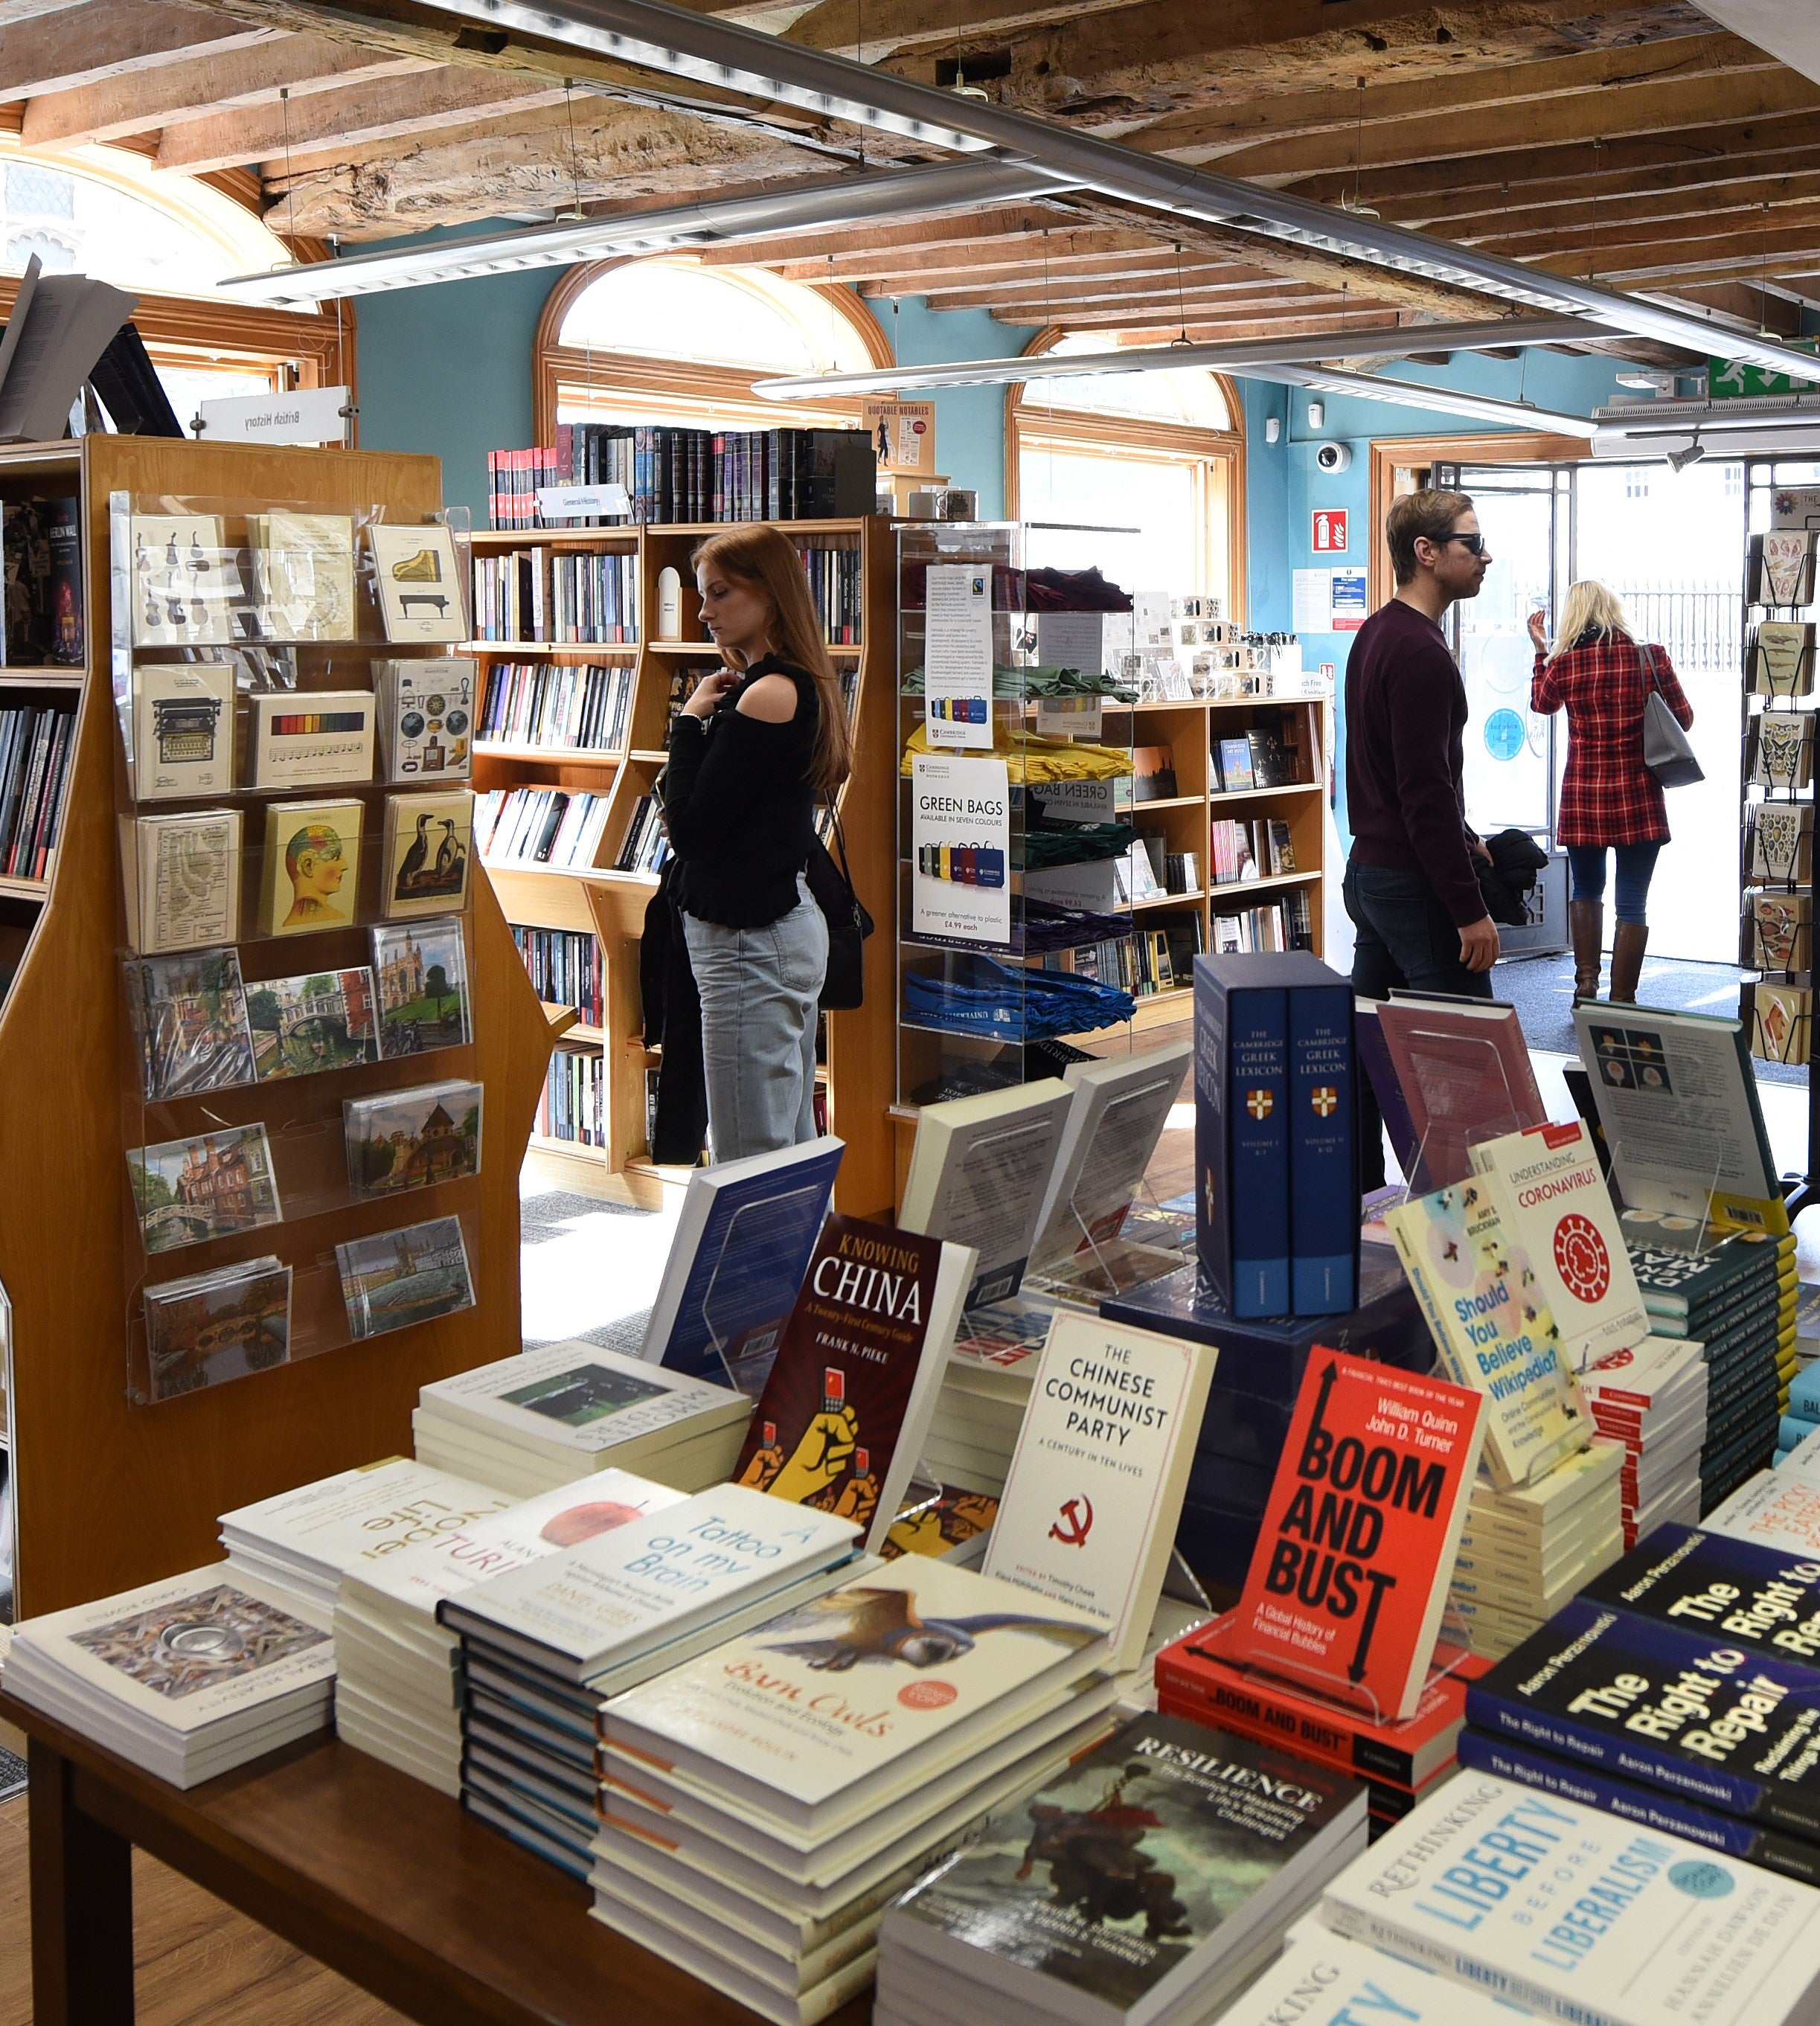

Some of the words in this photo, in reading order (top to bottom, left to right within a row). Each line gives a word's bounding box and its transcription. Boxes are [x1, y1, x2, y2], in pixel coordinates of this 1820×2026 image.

[868, 405, 897, 415] QUOTABLE
[899, 405, 929, 415] NOTABLES
[920, 795, 964, 813] GREEN
[967, 799, 1004, 816] BAGS
[920, 814, 947, 823] AVAILABLE
[948, 815, 955, 824] IN
[956, 816, 974, 825] SEVEN
[975, 818, 1003, 827] COLOURS
[926, 910, 947, 919] greener
[948, 909, 976, 921] alternative
[984, 914, 1003, 924] plastic
[943, 920, 961, 930] £4.99
[962, 923, 978, 931] each
[1233, 1039, 1284, 1048] CAMBRIDGE
[1251, 1030, 1267, 1039] THE
[1297, 1037, 1347, 1047] CAMBRIDGE
[1315, 1028, 1331, 1036] THE
[1235, 1065, 1283, 1077] LEXICON
[1241, 1051, 1278, 1062] GREEK
[1300, 1062, 1347, 1074] LEXICON
[1306, 1049, 1340, 1061] GREEK
[1509, 1151, 1576, 1184] UNDERSTANDING
[1518, 1167, 1598, 1208] CORONAVIRUS
[1467, 1216, 1502, 1237] BRUCKMAN
[838, 1234, 920, 1274] KNOWING
[813, 1255, 922, 1326] CHINA
[1455, 1278, 1510, 1323] Should
[804, 1302, 813, 1313] A
[861, 1318, 892, 1339] Century
[1465, 1319, 1499, 1350] You
[816, 1331, 851, 1353] FRANK
[850, 1342, 860, 1356] N.
[860, 1346, 890, 1365] PIEKE
[1103, 1343, 1132, 1365] THE
[1476, 1333, 1534, 1376] Believe
[1069, 1358, 1156, 1399] CHINESE
[1487, 1348, 1559, 1403] Wikipedia?
[1045, 1378, 1168, 1431] COMMUNIST
[1377, 1396, 1420, 1425] William
[1420, 1409, 1458, 1436] Quinn
[1066, 1411, 1131, 1447] PARTY
[1365, 1414, 1396, 1437] John
[1396, 1423, 1410, 1442] D.
[1414, 1426, 1455, 1454] Turner
[1038, 1437, 1045, 1446] A
[1046, 1439, 1086, 1461] CENTURY
[1087, 1451, 1098, 1463] IN
[1099, 1455, 1117, 1470] TEN
[1118, 1460, 1143, 1478] LIVES
[1297, 1426, 1447, 1519] BOOM
[362, 1498, 453, 1531] Life
[781, 1523, 821, 1546] A
[1279, 1484, 1385, 1560] AND
[646, 1534, 693, 1555] on
[696, 1551, 753, 1576] my
[688, 1514, 783, 1560] Tattoo
[624, 1551, 711, 1594] Brain
[1048, 1572, 1074, 1592] Timothy
[1265, 1539, 1397, 1629] BUST
[1621, 1568, 1653, 1603] Aaron
[1650, 1532, 1707, 1580] Perzanowski
[1667, 1583, 1740, 1621] The
[1720, 1578, 1807, 1640] Right
[1778, 1562, 1820, 1587] to
[1252, 1617, 1291, 1642] Financial
[1291, 1630, 1328, 1656] Bubbles
[1256, 1603, 1265, 1615] A
[1265, 1602, 1291, 1627] Global
[1292, 1611, 1324, 1637] History
[1324, 1626, 1337, 1641] of
[1516, 1661, 1557, 1696] Aaron
[1554, 1612, 1618, 1668] Perzanowski
[722, 1659, 803, 1702] Barn
[807, 1692, 895, 1739] Owls
[722, 1679, 775, 1707] Evolution
[774, 1700, 798, 1716] and
[798, 1710, 846, 1737] Ecology
[1566, 1673, 1650, 1719] The
[1625, 1670, 1722, 1741] Right
[1693, 1648, 1746, 1676] to
[1215, 1687, 1260, 1722] BOOM
[1265, 1708, 1295, 1734] AND
[1301, 1720, 1342, 1751] BUST
[1679, 1674, 1789, 1761] Repair
[1132, 1735, 1324, 1813] RESILIENCE
[1499, 1711, 1521, 1731] The
[1521, 1720, 1554, 1745] Right
[1553, 1731, 1566, 1746] to
[1566, 1734, 1606, 1759] Repair
[1617, 1751, 1654, 1777] Aaron
[1656, 1764, 1733, 1803] Perzanowski
[1161, 1762, 1183, 1779] The
[1182, 1770, 1229, 1795] Science
[1228, 1787, 1245, 1799] of
[1243, 1791, 1307, 1824] Mastering
[1206, 1789, 1242, 1811] Life's
[1241, 1803, 1297, 1833] Greatest
[1490, 1755, 1513, 1775] The
[1513, 1765, 1545, 1789] Right
[1545, 1775, 1559, 1790] to
[1558, 1777, 1598, 1803] Repair
[1610, 1796, 1647, 1822] Aaron
[1647, 1809, 1727, 1848] Perzanowski
[1217, 1806, 1287, 1841] Challenges
[1366, 1782, 1507, 1902] RETHINKING
[1412, 1795, 1582, 1934] LIBERTY
[1512, 1836, 1603, 1927] BEFORE
[1531, 1835, 1677, 1974] LIBERALISM
[1034, 1914, 1078, 1939] DENNIS
[1455, 1955, 1508, 1992] LIBERTY
